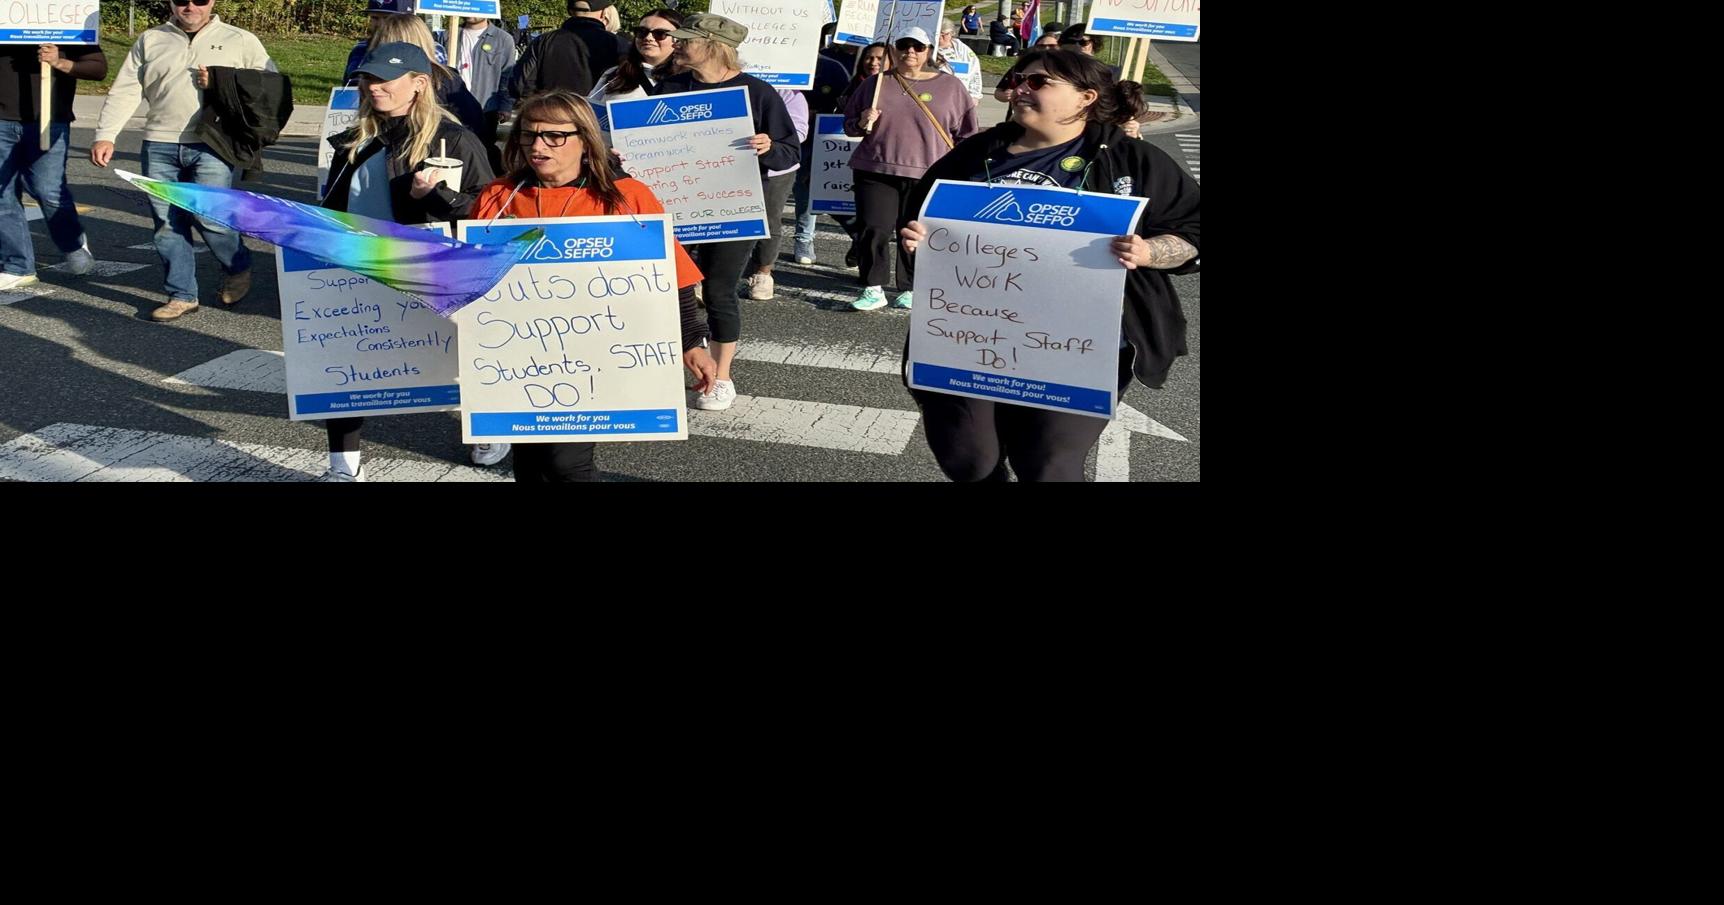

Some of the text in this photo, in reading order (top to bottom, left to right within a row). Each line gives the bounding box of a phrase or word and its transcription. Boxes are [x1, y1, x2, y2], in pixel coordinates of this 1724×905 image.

[0, 1, 95, 25] OLLEGES
[722, 0, 784, 14] WITHOUT
[743, 36, 798, 46] UMBLE!
[680, 102, 713, 114] OPSEU
[679, 110, 713, 121] SEFPO
[822, 140, 852, 153] Did
[823, 182, 851, 192] rais
[690, 208, 715, 219] OUR
[1028, 203, 1081, 217] OPSEU
[1024, 212, 1075, 227] SEFPO
[563, 236, 615, 249] OPSEU
[674, 231, 706, 240] ravaillons
[563, 247, 614, 260] SEFPO
[927, 227, 1039, 269] Colleges
[587, 263, 671, 299] don't
[294, 297, 382, 323] Exceeding
[929, 288, 1025, 324] Because
[297, 323, 391, 348] Expectations
[477, 305, 625, 352] Support
[927, 318, 1008, 345] Support
[356, 330, 453, 354] Consistently
[609, 341, 678, 369] STAFF
[325, 362, 421, 386] Students
[972, 373, 1047, 392] We work for you!
[383, 390, 395, 400] for
[949, 378, 1071, 403] Nous travaillons pour vous!
[536, 413, 611, 424] We work for you
[511, 422, 636, 433] Nous travaillons pour vous
